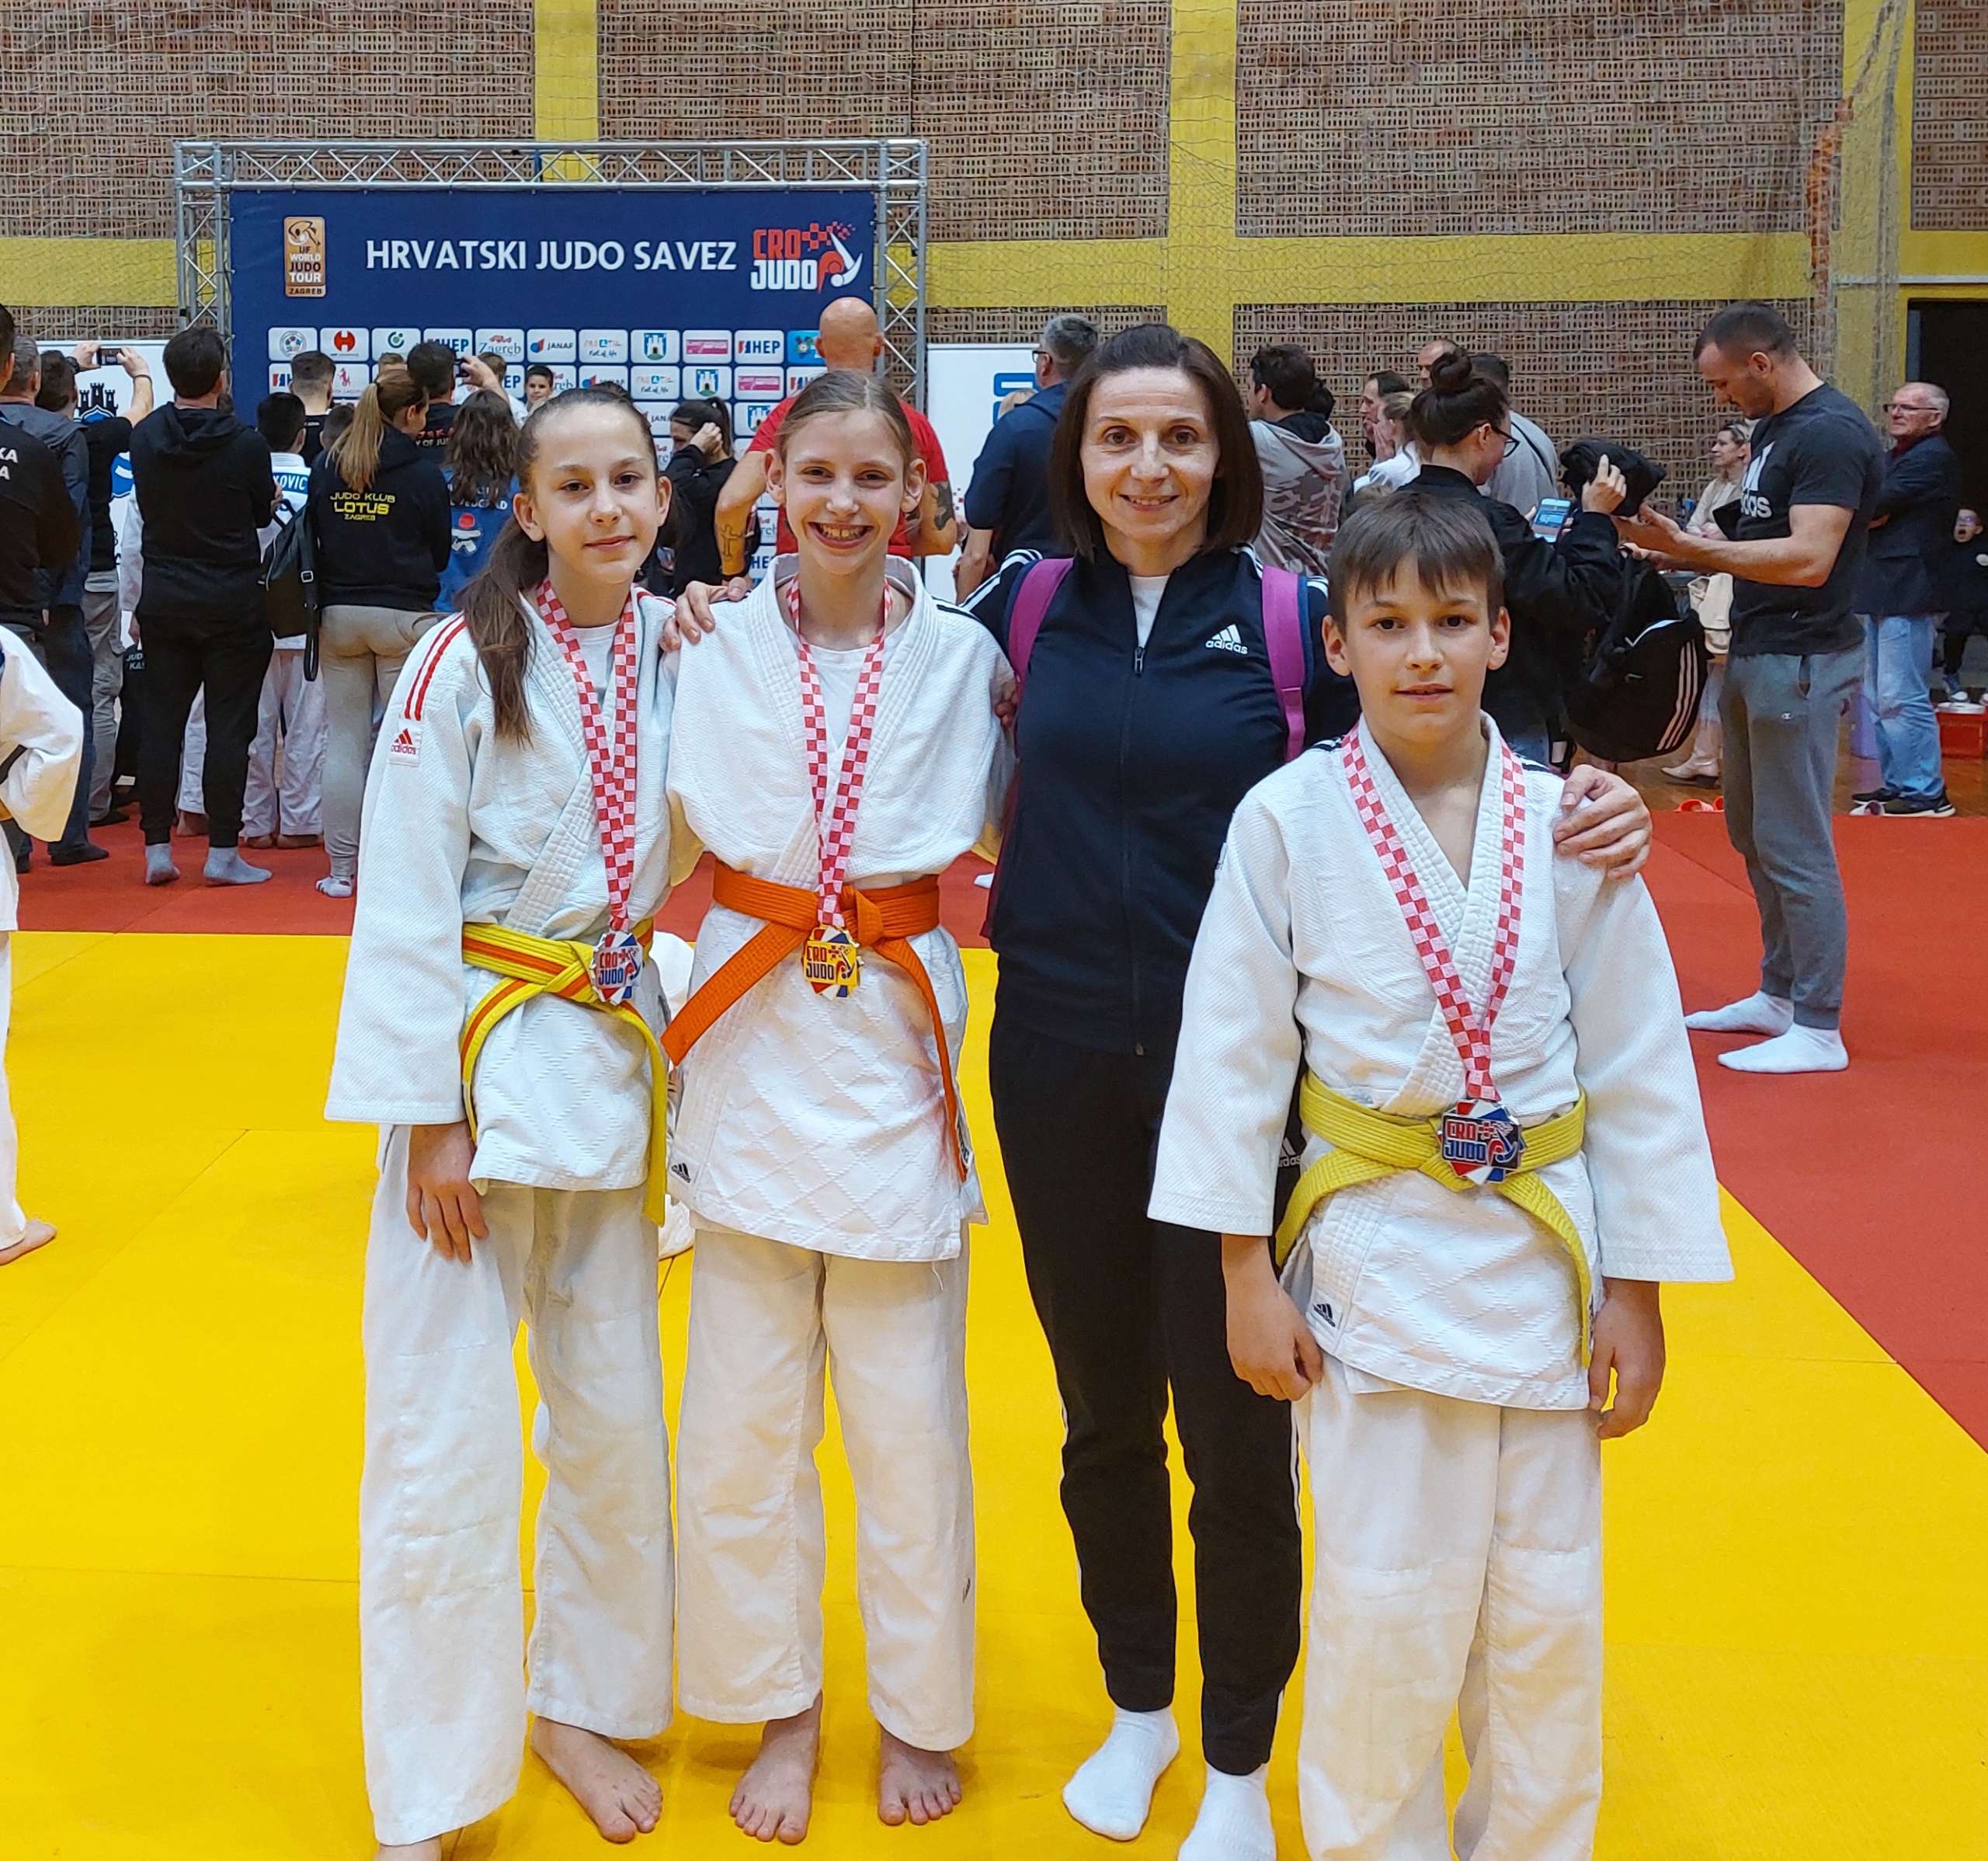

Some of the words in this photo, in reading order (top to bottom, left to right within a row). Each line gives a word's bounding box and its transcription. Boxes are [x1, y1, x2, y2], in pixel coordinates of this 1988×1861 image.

[752, 228, 801, 259] CRO
[290, 253, 321, 262] WORLD
[366, 239, 526, 270] HRVATSKI
[535, 240, 624, 270] JUDO
[634, 240, 737, 270] SAVEZ
[289, 262, 321, 272] JUDO
[750, 259, 818, 290] JUDO
[288, 273, 321, 283] TOUR
[547, 342, 574, 351] JANAF
[752, 340, 780, 354] HEP
[503, 375, 521, 389] EP
[329, 492, 360, 500] JUDO
[364, 492, 396, 503] KLUB
[334, 502, 390, 515] LOTUS
[751, 556, 769, 569] HE
[1205, 638, 1249, 655] adidas
[390, 745, 416, 755] adidas
[600, 951, 618, 969] CRO
[806, 945, 827, 962] CRO
[598, 968, 624, 986] JUDO
[806, 962, 835, 980] JUDO
[1446, 1120, 1476, 1142] CRO
[1444, 1139, 1486, 1163] JUDO
